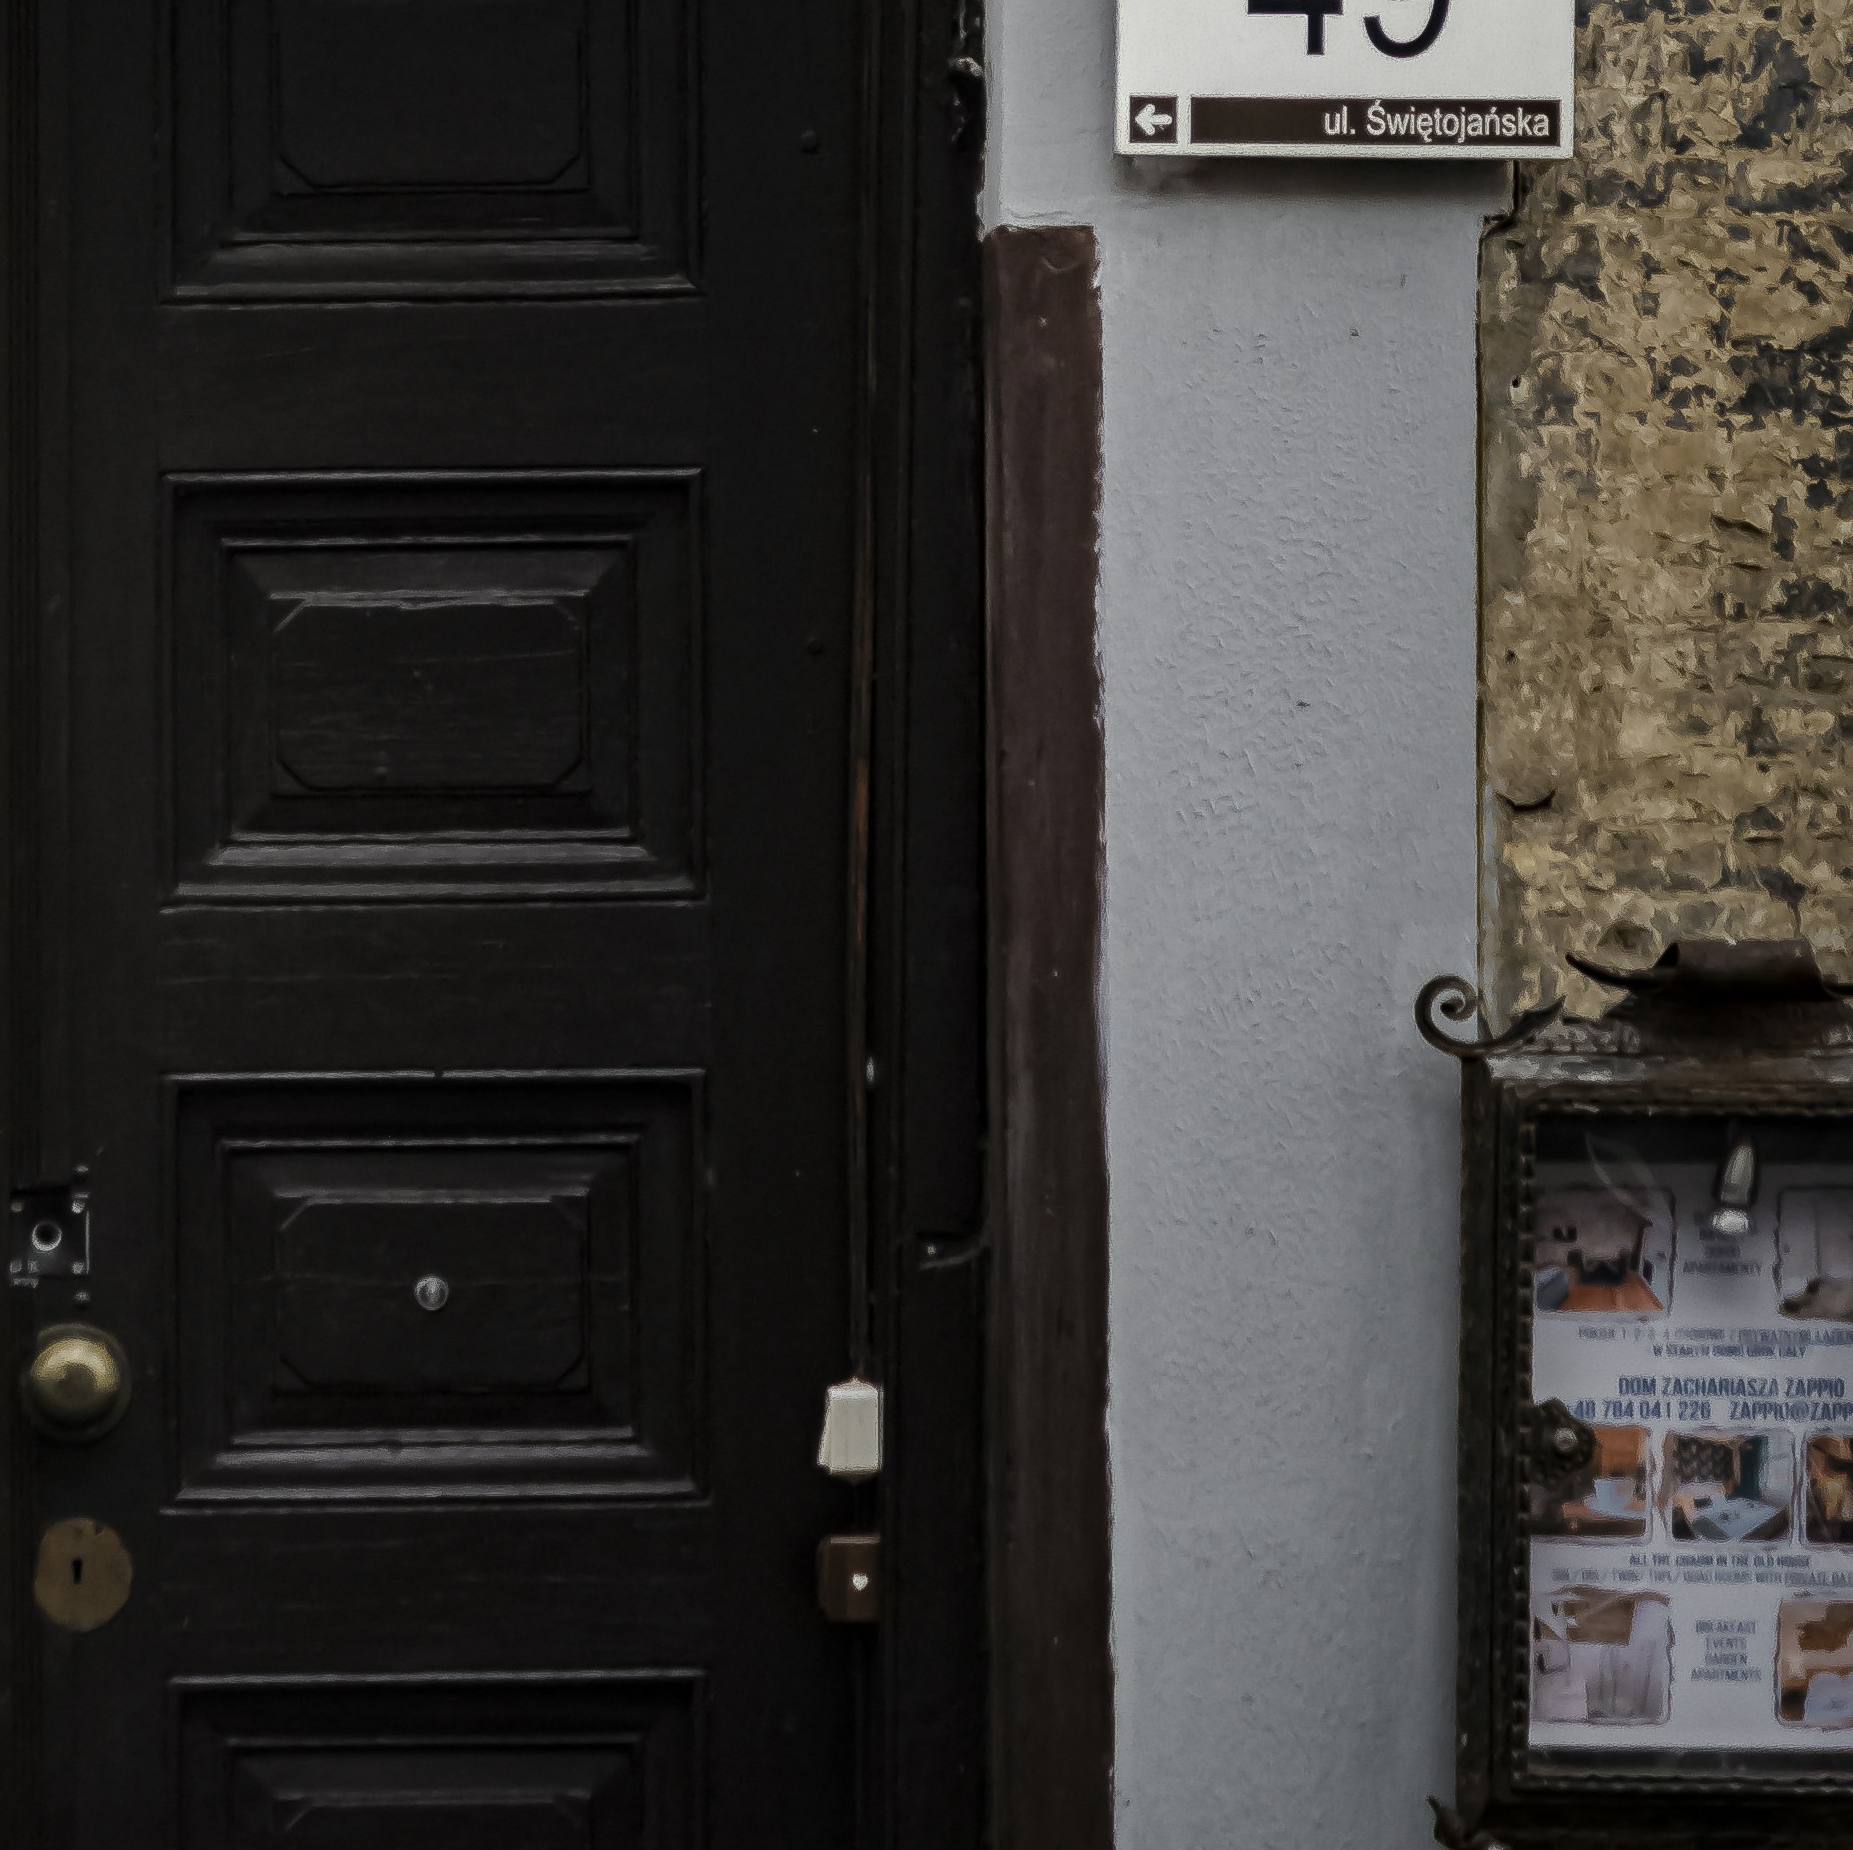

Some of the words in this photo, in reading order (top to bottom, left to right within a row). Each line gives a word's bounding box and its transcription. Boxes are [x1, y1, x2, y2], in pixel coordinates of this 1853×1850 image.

[1325, 105, 1355, 135] ul.
[1367, 100, 1549, 143] Świętojańska
[1618, 1377, 1656, 1396] DOM
[1662, 1377, 1779, 1397] ZACHARIASZA
[1785, 1377, 1845, 1398] ZAPPIO
